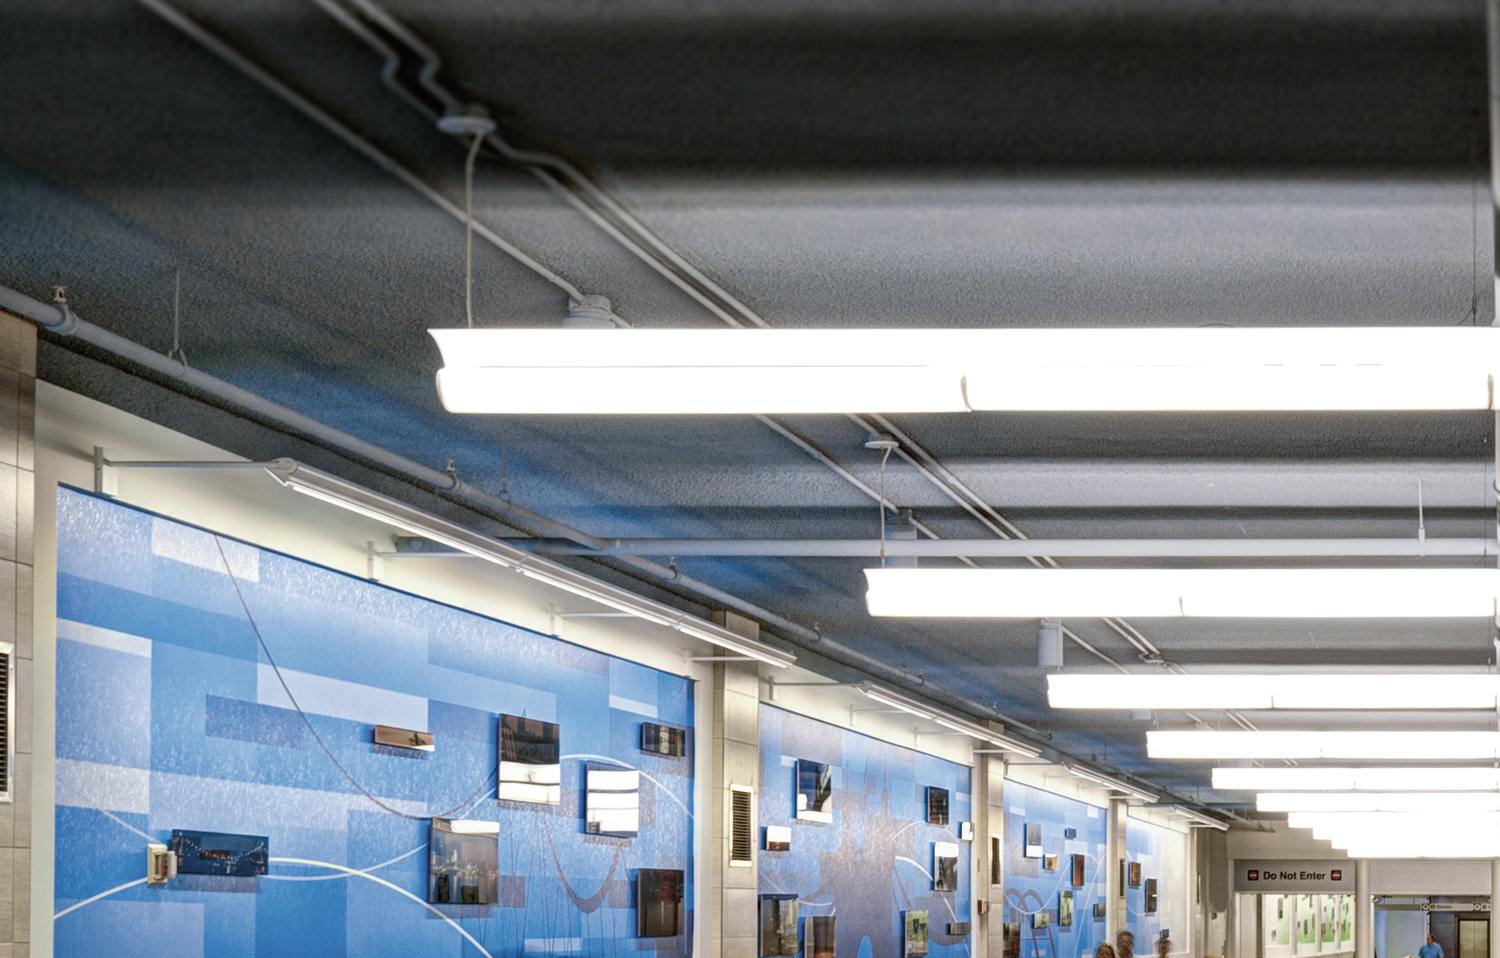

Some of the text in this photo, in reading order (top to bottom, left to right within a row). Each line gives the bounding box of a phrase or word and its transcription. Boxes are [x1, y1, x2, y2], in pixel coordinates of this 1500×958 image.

[1263, 871, 1326, 880] Do Not Enter
